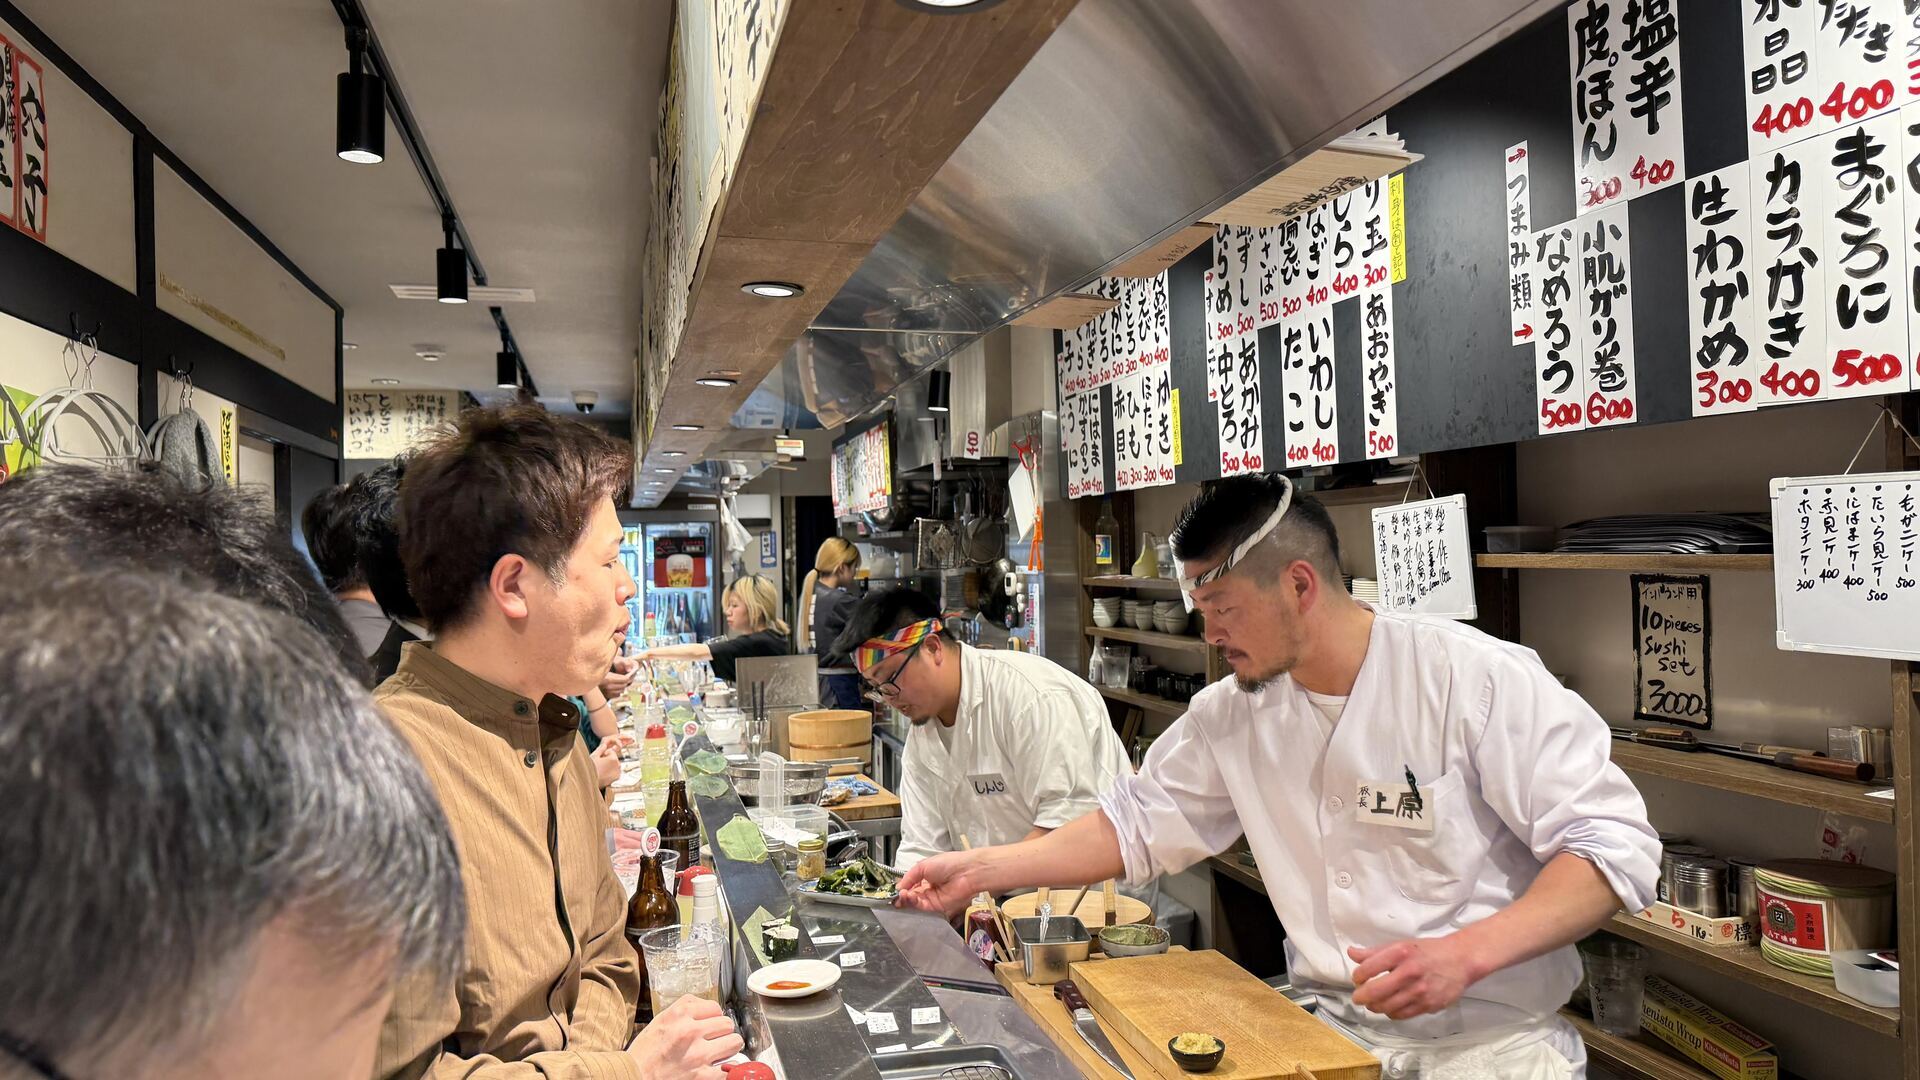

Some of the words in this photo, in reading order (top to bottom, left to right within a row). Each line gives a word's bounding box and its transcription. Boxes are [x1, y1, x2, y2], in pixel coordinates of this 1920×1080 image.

[1621, 0, 1677, 134] 塩辛
[1819, 79, 1895, 123] 400
[1753, 97, 1813, 138] 400
[1629, 155, 1675, 189] 400
[1581, 175, 1621, 208] 300
[1831, 126, 1896, 330] まぐろに
[1508, 174, 1532, 312] つまみ類
[1332, 272, 1358, 295] 400
[1364, 263, 1387, 288] 300
[1692, 175, 1749, 369] 生わかめ
[1282, 297, 1301, 317] 500
[1306, 285, 1328, 307] 400
[1260, 302, 1279, 321] 500
[1536, 228, 1574, 394] なめろう
[1217, 322, 1233, 341] 500
[1238, 312, 1254, 335] 500
[1139, 350, 1153, 368] 400
[1154, 346, 1168, 363] 400
[1366, 293, 1393, 427] あおやぎ
[1100, 368, 1110, 383] 500
[1112, 361, 1123, 378] 500
[1125, 359, 1137, 374] 300
[1308, 317, 1334, 430] いわし
[1832, 349, 1903, 388] 500
[1065, 377, 1075, 392] 400
[1076, 376, 1086, 389] 400
[1088, 371, 1098, 388] 300
[1284, 328, 1304, 432] たこ
[1696, 370, 1752, 407] 300
[1760, 362, 1820, 396] 400
[1218, 343, 1238, 443] 中とろ
[1238, 337, 1260, 449] あかみ
[1156, 370, 1171, 454] かき
[1541, 398, 1581, 429] 500
[1586, 392, 1633, 425] 600
[1127, 391, 1140, 459] ひも
[966, 431, 979, 456] 400
[1287, 444, 1308, 462] 400
[1312, 437, 1335, 462] 400
[1368, 430, 1394, 456] 500
[1159, 464, 1173, 480] 400
[1222, 452, 1239, 473] 500
[1242, 451, 1261, 470] 400
[1117, 470, 1128, 486] 400
[1130, 467, 1142, 484] 300
[1143, 465, 1156, 481] 300
[1796, 579, 1815, 592] 300
[1819, 568, 1839, 584] 400
[1843, 575, 1864, 590] 400
[1896, 576, 1916, 588] 500
[1867, 589, 1888, 601] 500
[974, 780, 1005, 795] しんじ
[1676, 1020, 1702, 1050] Wrap
